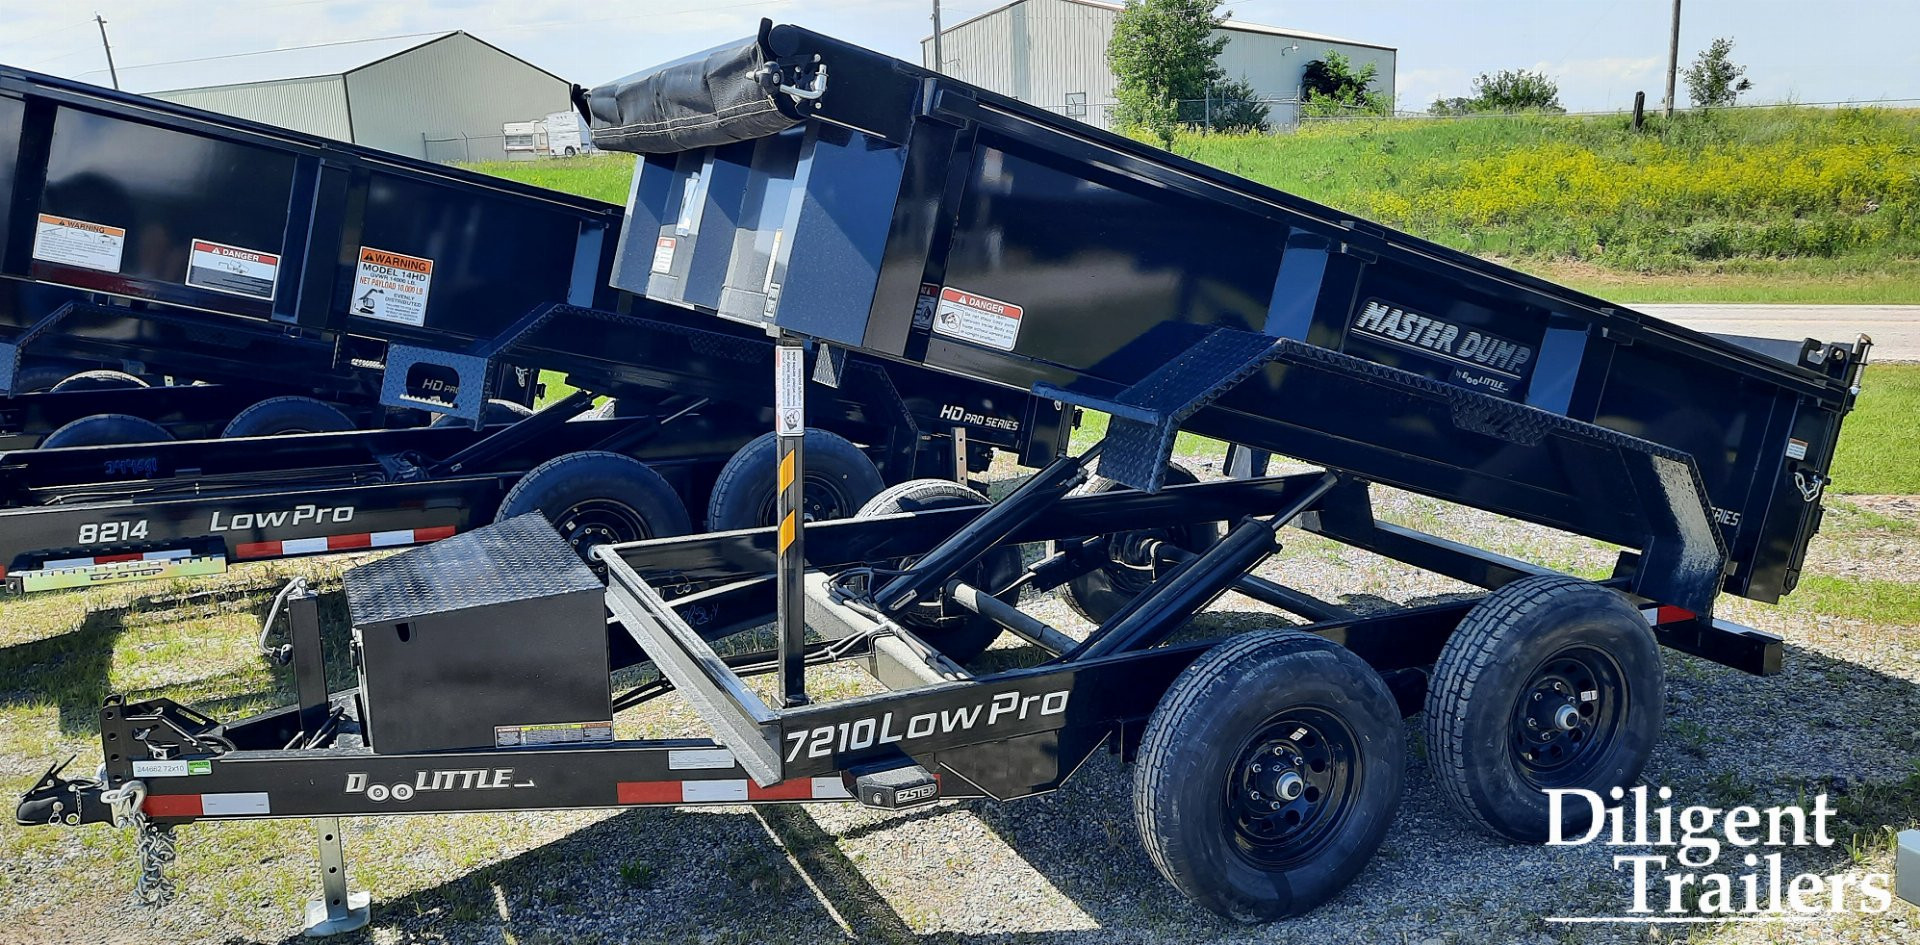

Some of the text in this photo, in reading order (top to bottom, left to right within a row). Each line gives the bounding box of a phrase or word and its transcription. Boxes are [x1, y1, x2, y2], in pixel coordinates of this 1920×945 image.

[67, 220, 105, 233] WARNING
[222, 248, 259, 262] DANGER
[375, 253, 426, 272] WARNING
[362, 263, 426, 282] MODEL 14HD
[360, 276, 371, 285] NET
[371, 277, 397, 290] PAYLOAD
[384, 296, 422, 308] DISTRIBUTED
[393, 293, 415, 301] EVENLY
[969, 298, 1004, 314] DANGER
[1356, 301, 1531, 372] MASTER DUMP
[422, 378, 444, 391] HD
[940, 404, 1019, 431] HD PRO SERIES
[1710, 506, 1741, 527] RIES
[78, 519, 150, 545] 8214
[785, 718, 876, 763] 7210
